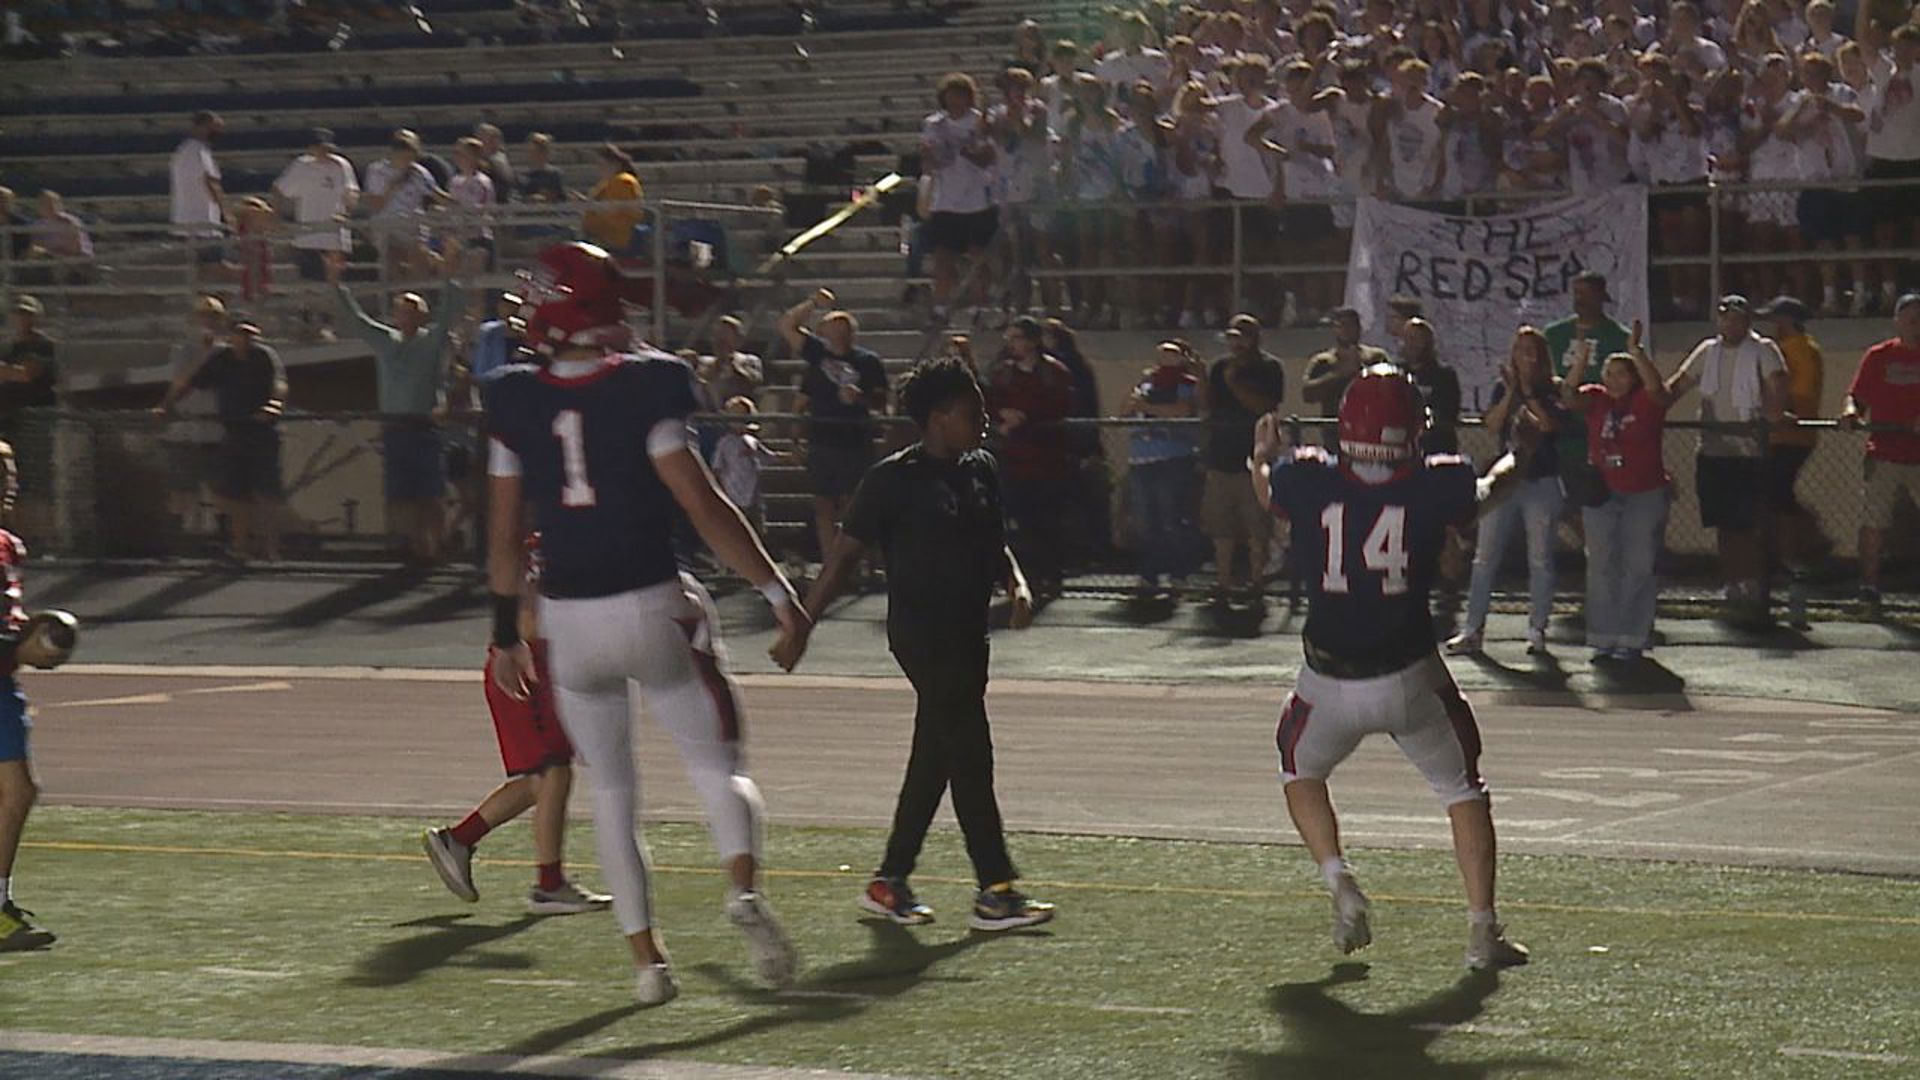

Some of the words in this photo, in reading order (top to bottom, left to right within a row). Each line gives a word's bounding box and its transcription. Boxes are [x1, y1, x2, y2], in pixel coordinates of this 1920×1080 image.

[1445, 217, 1553, 251] THE
[1394, 250, 1492, 302] RED
[1505, 250, 1584, 301] SEA
[551, 409, 597, 506] 1
[1320, 502, 1410, 595] 14
